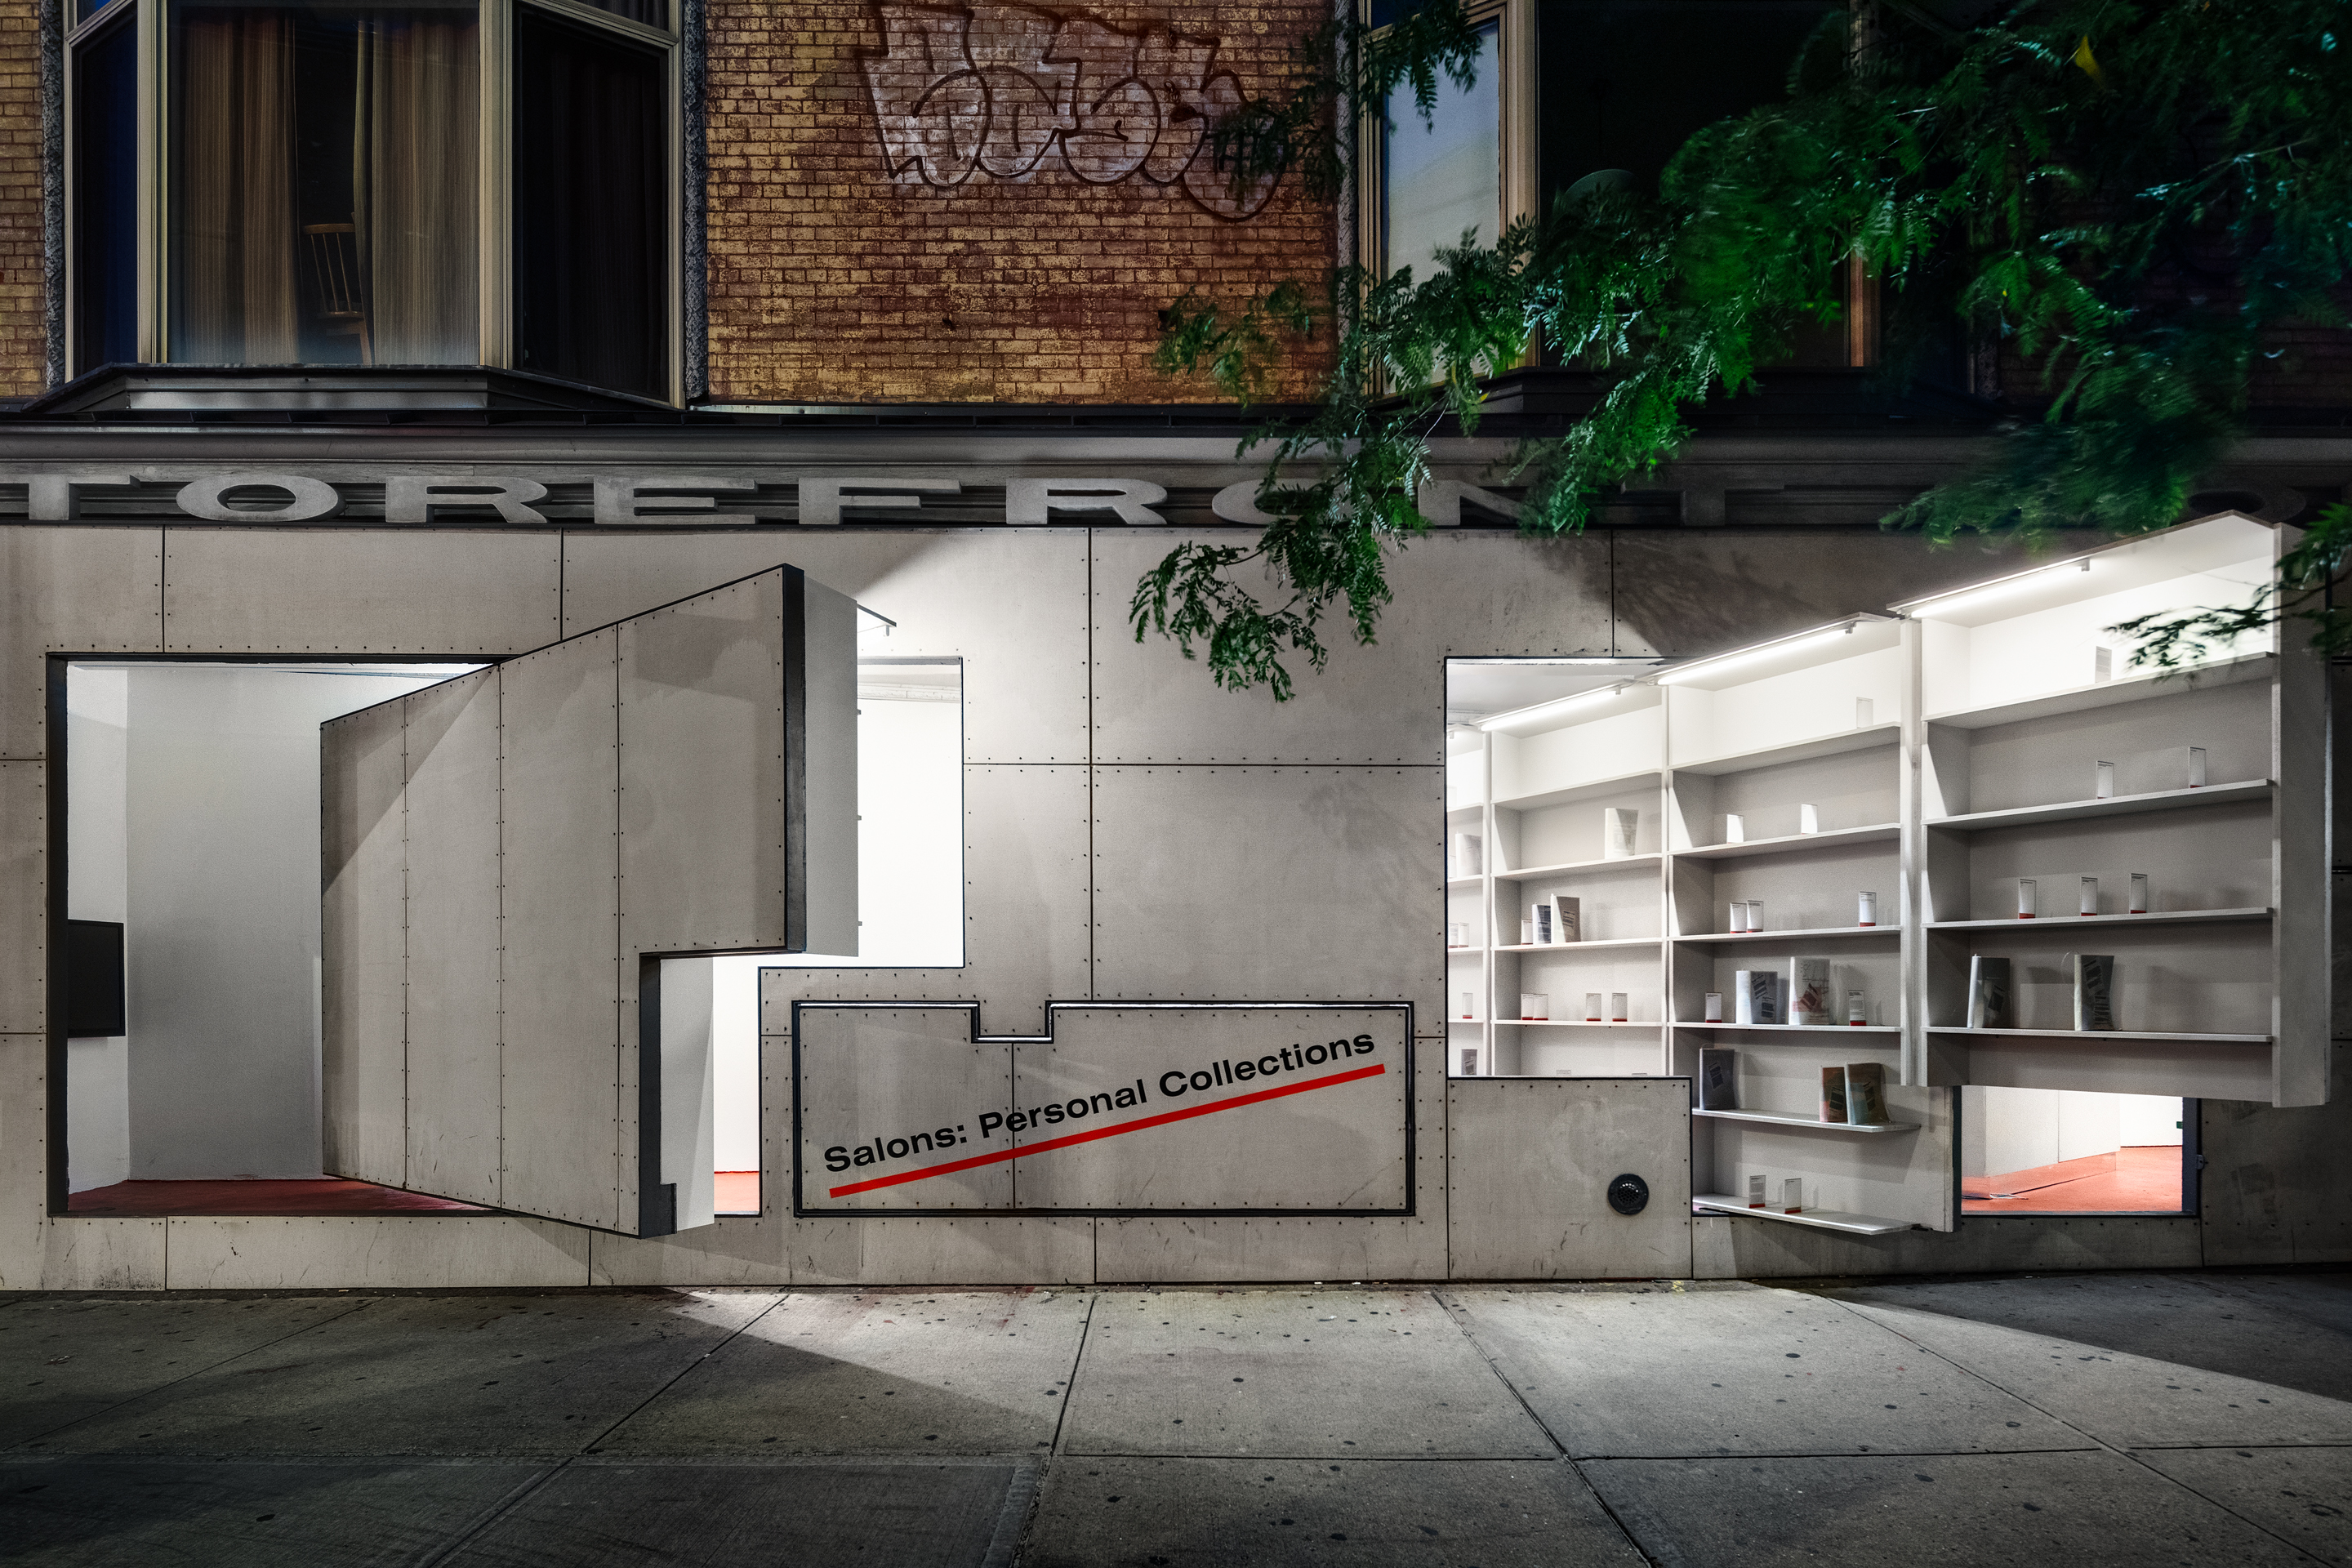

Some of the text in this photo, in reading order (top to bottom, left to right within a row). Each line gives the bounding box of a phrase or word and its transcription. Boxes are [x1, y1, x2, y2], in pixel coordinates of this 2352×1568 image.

[823, 1033, 1375, 1174] Salons: Personal Collections
